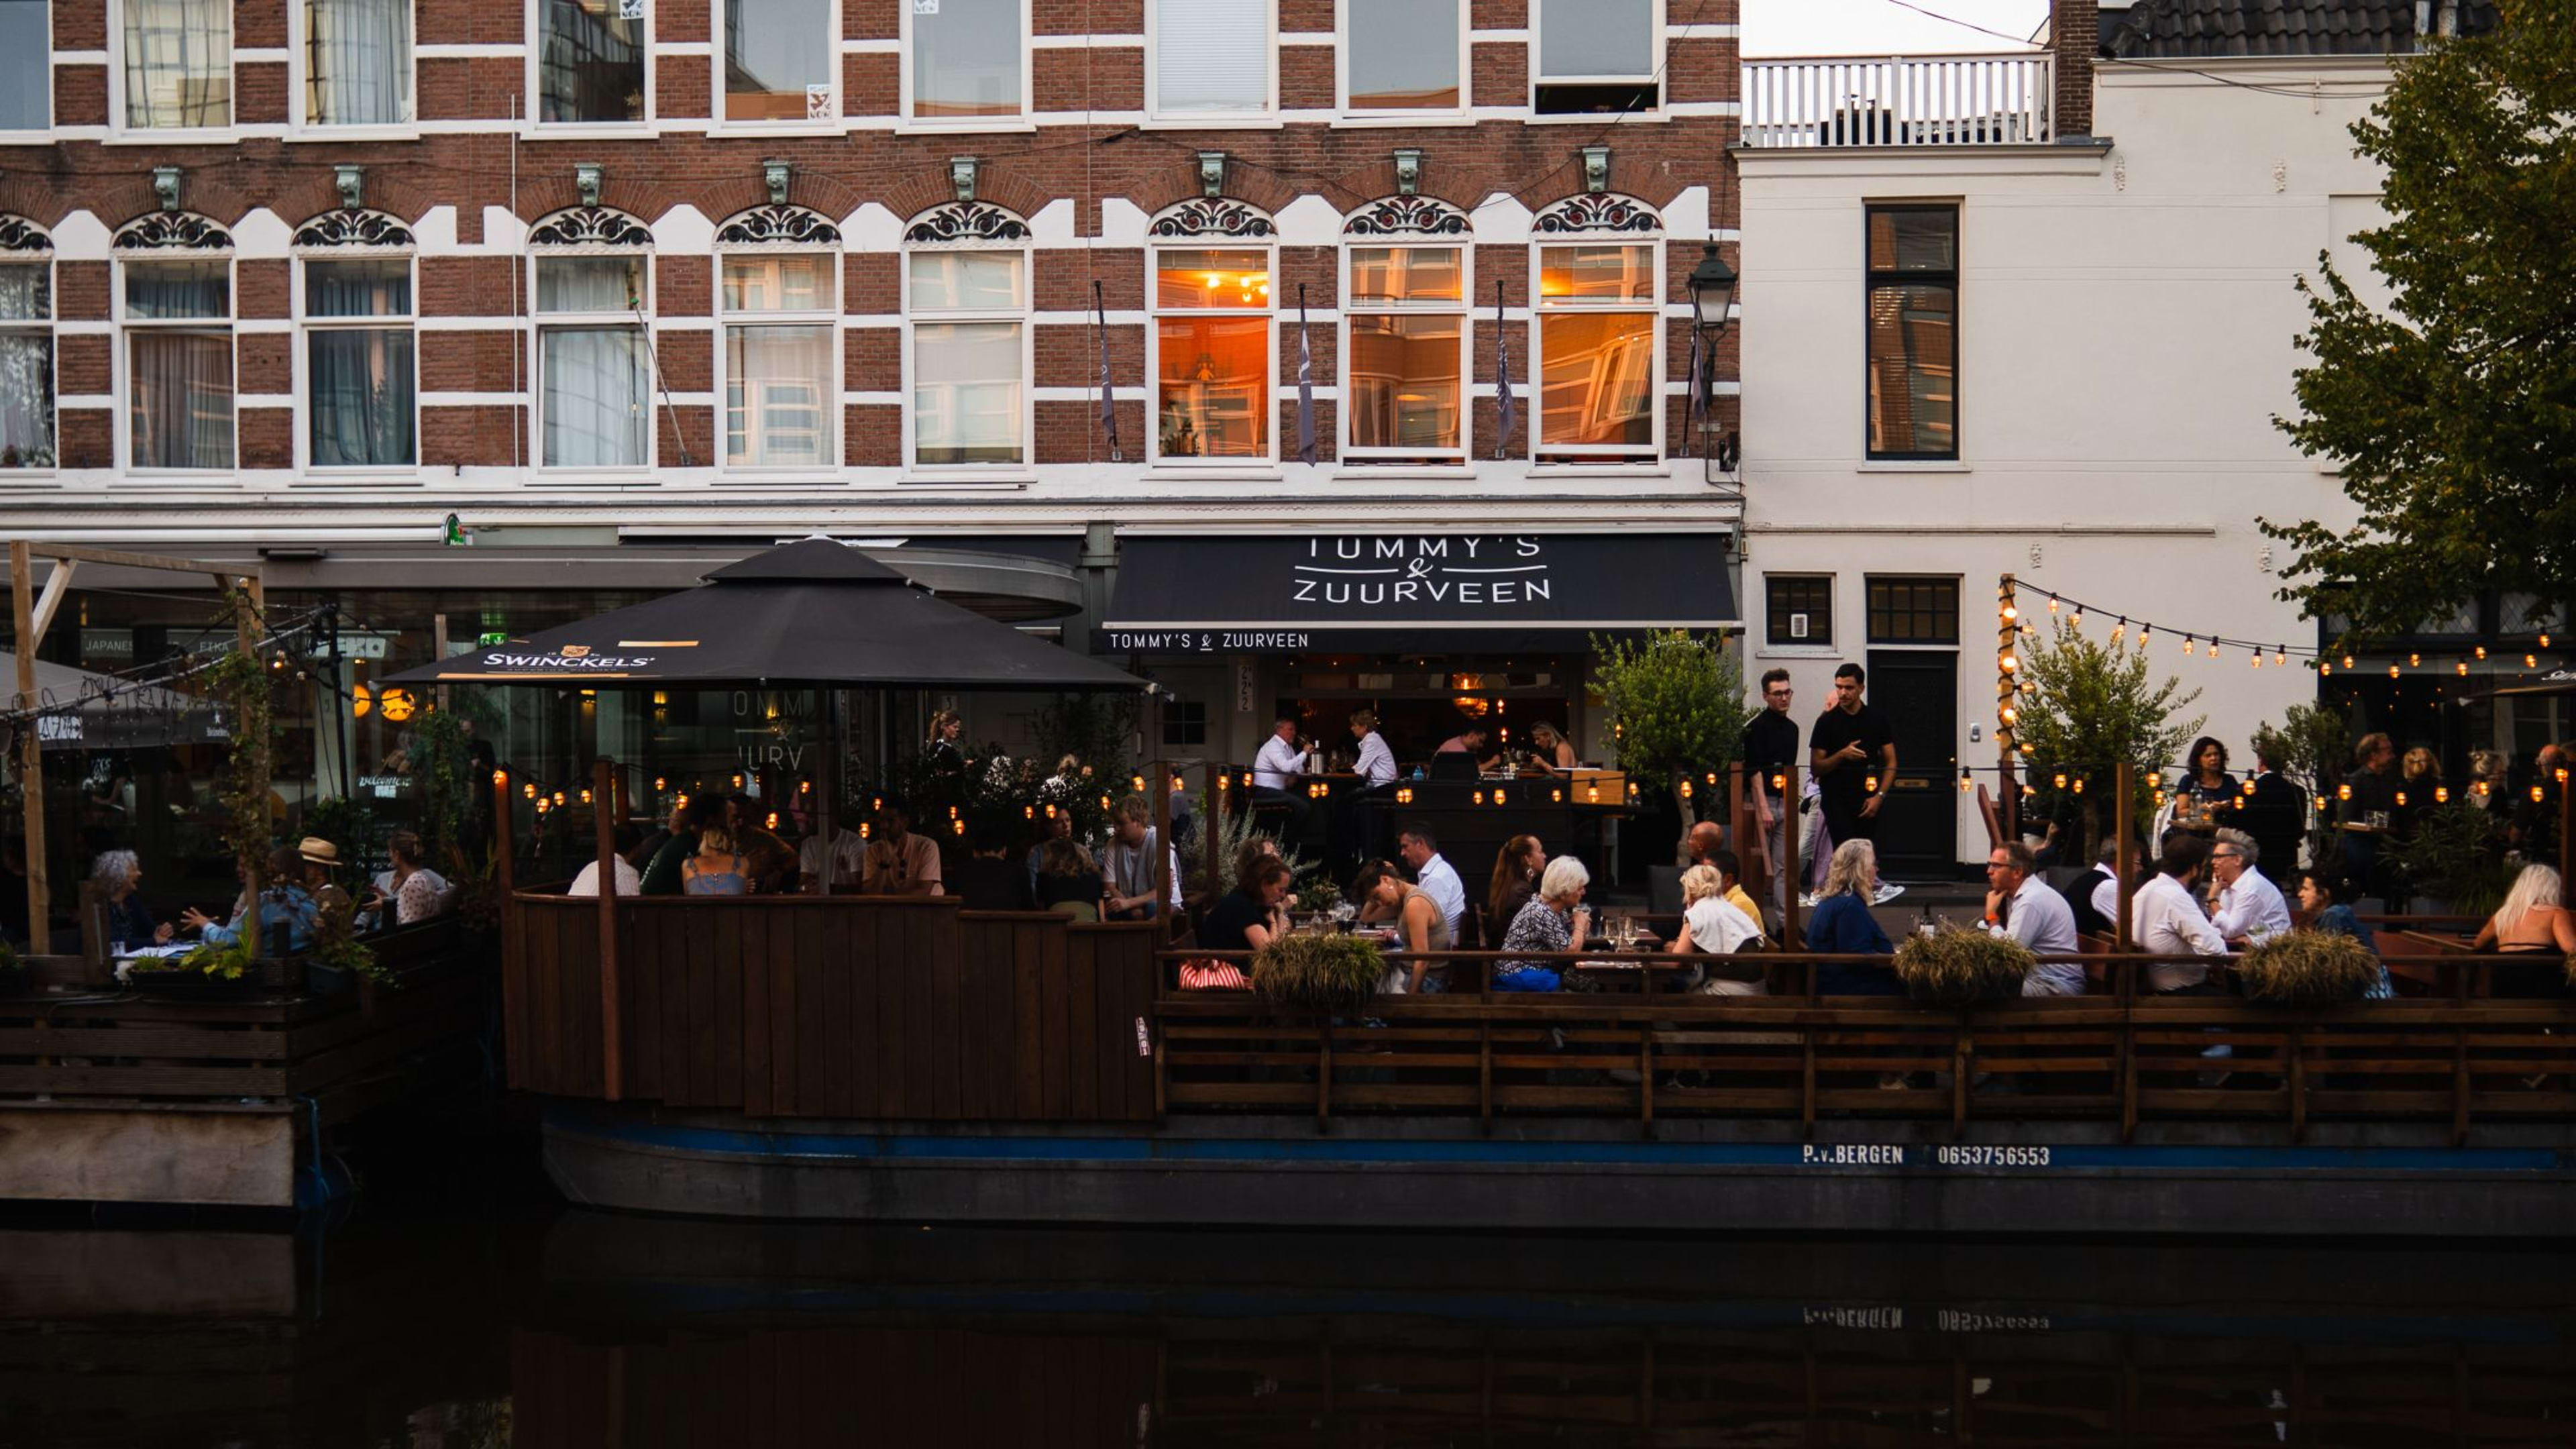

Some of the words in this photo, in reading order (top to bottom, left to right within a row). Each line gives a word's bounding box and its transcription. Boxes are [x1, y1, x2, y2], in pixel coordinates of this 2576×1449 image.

[1406, 557, 1434, 578] &
[1293, 578, 1550, 604] ZUURVEEN
[1110, 633, 1191, 648] TOMMY'S
[1222, 633, 1308, 647] ZUURVEEN
[483, 653, 656, 667] SWINCKELS'
[1938, 1146, 2050, 1165] 0653756553
